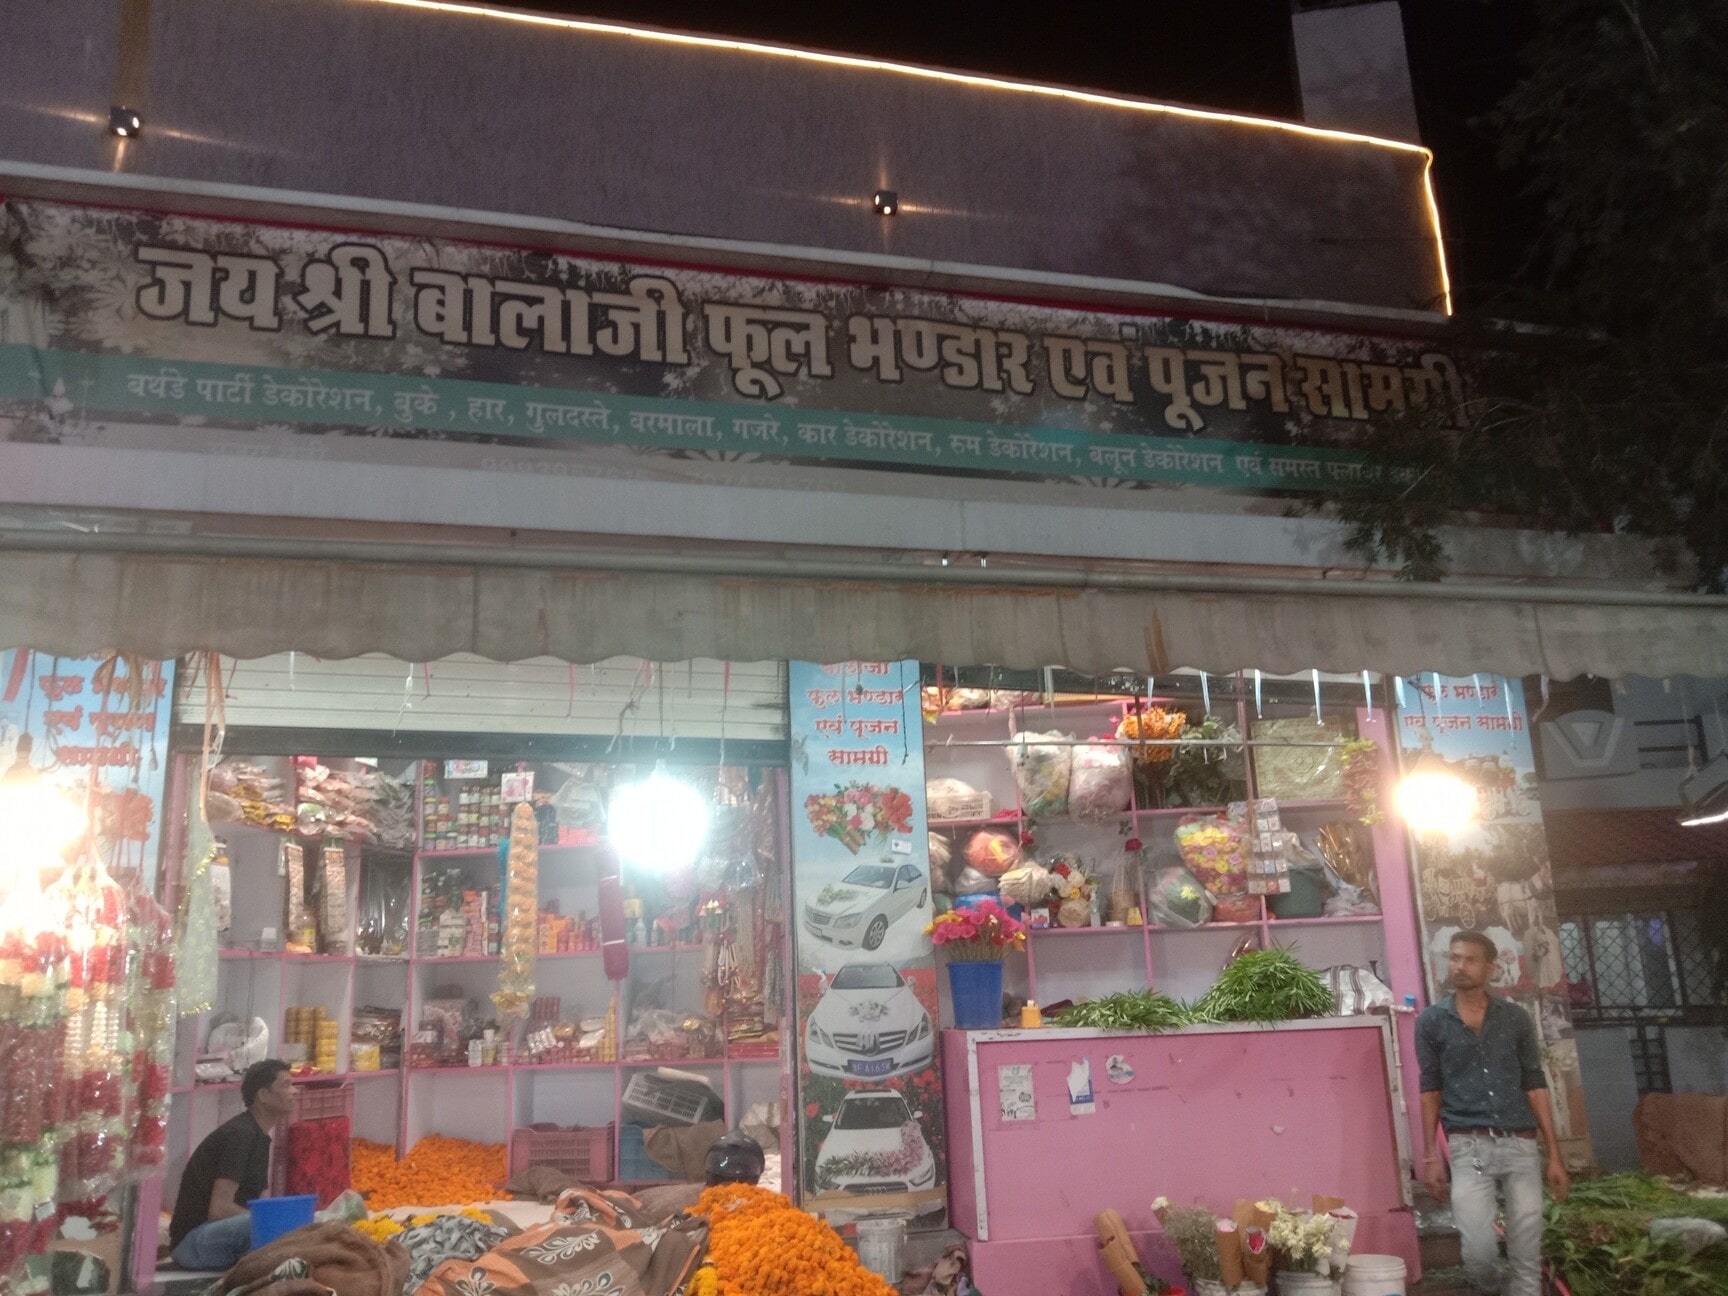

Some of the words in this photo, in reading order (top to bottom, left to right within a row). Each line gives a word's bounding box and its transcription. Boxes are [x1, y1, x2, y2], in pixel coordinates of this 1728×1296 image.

[133, 243, 281, 331] जय
[298, 241, 397, 340] श्री
[410, 266, 691, 366] बालाजी
[702, 300, 834, 401] फूल
[849, 313, 1034, 396] भण्डार
[1042, 321, 1138, 403] एवं
[1144, 344, 1290, 434] पूजन
[196, 372, 255, 405] पार्टी
[797, 422, 838, 446] कार
[849, 718, 900, 740] पूजन
